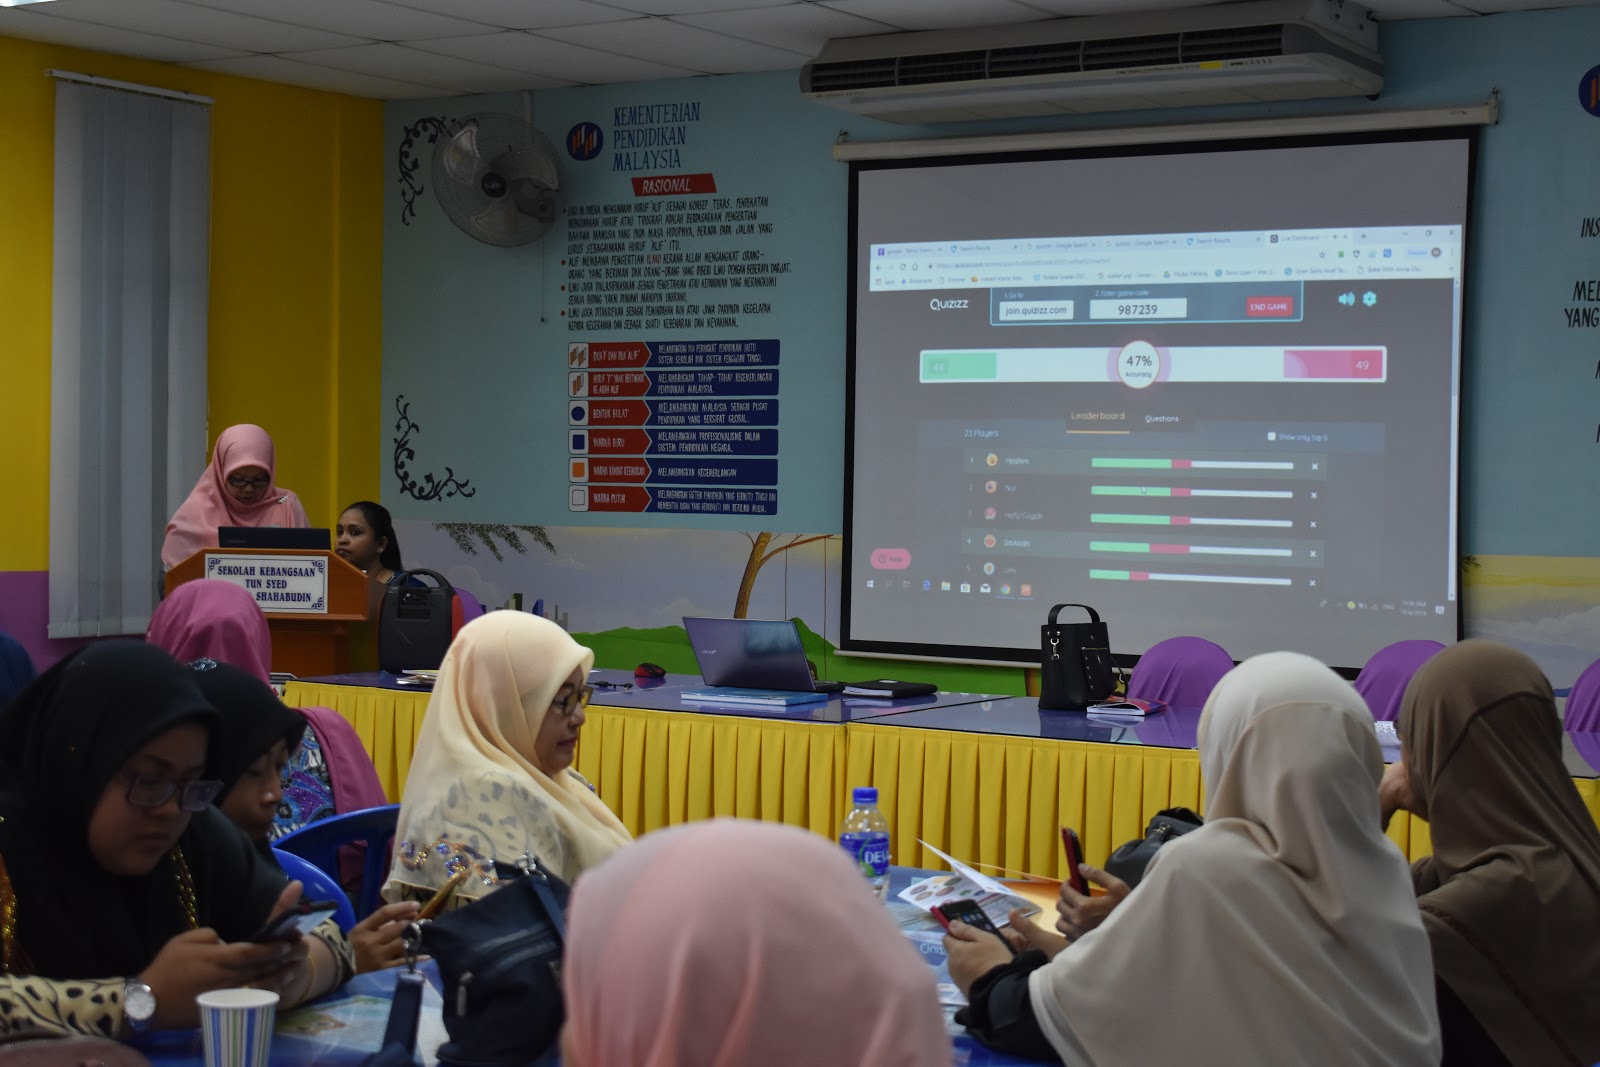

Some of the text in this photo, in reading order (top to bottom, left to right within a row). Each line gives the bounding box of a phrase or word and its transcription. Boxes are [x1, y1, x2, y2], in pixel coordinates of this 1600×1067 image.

[614, 102, 700, 127] KEMENTERIAN
[613, 126, 686, 149] PENDIDIKAN
[613, 149, 681, 172] MALAYSIA
[642, 177, 692, 194] RASIONAL
[666, 201, 686, 211] SEBAGAI
[689, 200, 708, 210] KONSEP
[736, 197, 769, 208] PENDEKATAN
[620, 216, 633, 226] ATAU
[725, 211, 757, 221] PENGERTIAN
[618, 230, 630, 239] YANG
[634, 229, 645, 238] PADA
[648, 228, 663, 237] MASA
[720, 225, 731, 235] PADA
[736, 224, 754, 235] JALAN
[758, 223, 773, 233] YANG
[1581, 217, 1600, 238] INS
[569, 256, 579, 267] ALIF
[612, 255, 644, 265] PENGERTIAN
[647, 254, 661, 264] ILMU
[686, 253, 701, 263] ALLAH
[568, 270, 585, 279] ORANG
[589, 269, 602, 278] YANG
[605, 267, 628, 278] BERIMAN
[632, 267, 641, 277] DAN
[682, 265, 694, 275] YANG
[730, 278, 742, 288] YANG
[1117, 290, 1133, 298] game
[687, 304, 700, 315] ATAU
[930, 298, 969, 311] Quizizz
[1005, 306, 1067, 316] join.quizizz.com
[1118, 305, 1158, 315] 987239
[694, 318, 704, 328] DAN
[1565, 308, 1599, 328] YANG
[1126, 355, 1152, 367] 47%
[1356, 360, 1369, 370] 49
[1125, 371, 1152, 379] Accuracy
[688, 385, 714, 393] MALAYSIA.
[702, 403, 727, 412] MALAYSIA
[753, 402, 768, 411] PUSAT
[612, 409, 629, 418] BULAT
[1071, 411, 1126, 420] Leaderboard
[1145, 414, 1179, 423] Questions
[688, 415, 701, 423] YANG
[974, 430, 999, 439] Players
[658, 443, 676, 452] SISTEM
[218, 566, 315, 577] SEKOLAH KEBANGSAAN
[246, 579, 287, 589] TUN SYED
[256, 592, 312, 602] SHAHABUDIN
